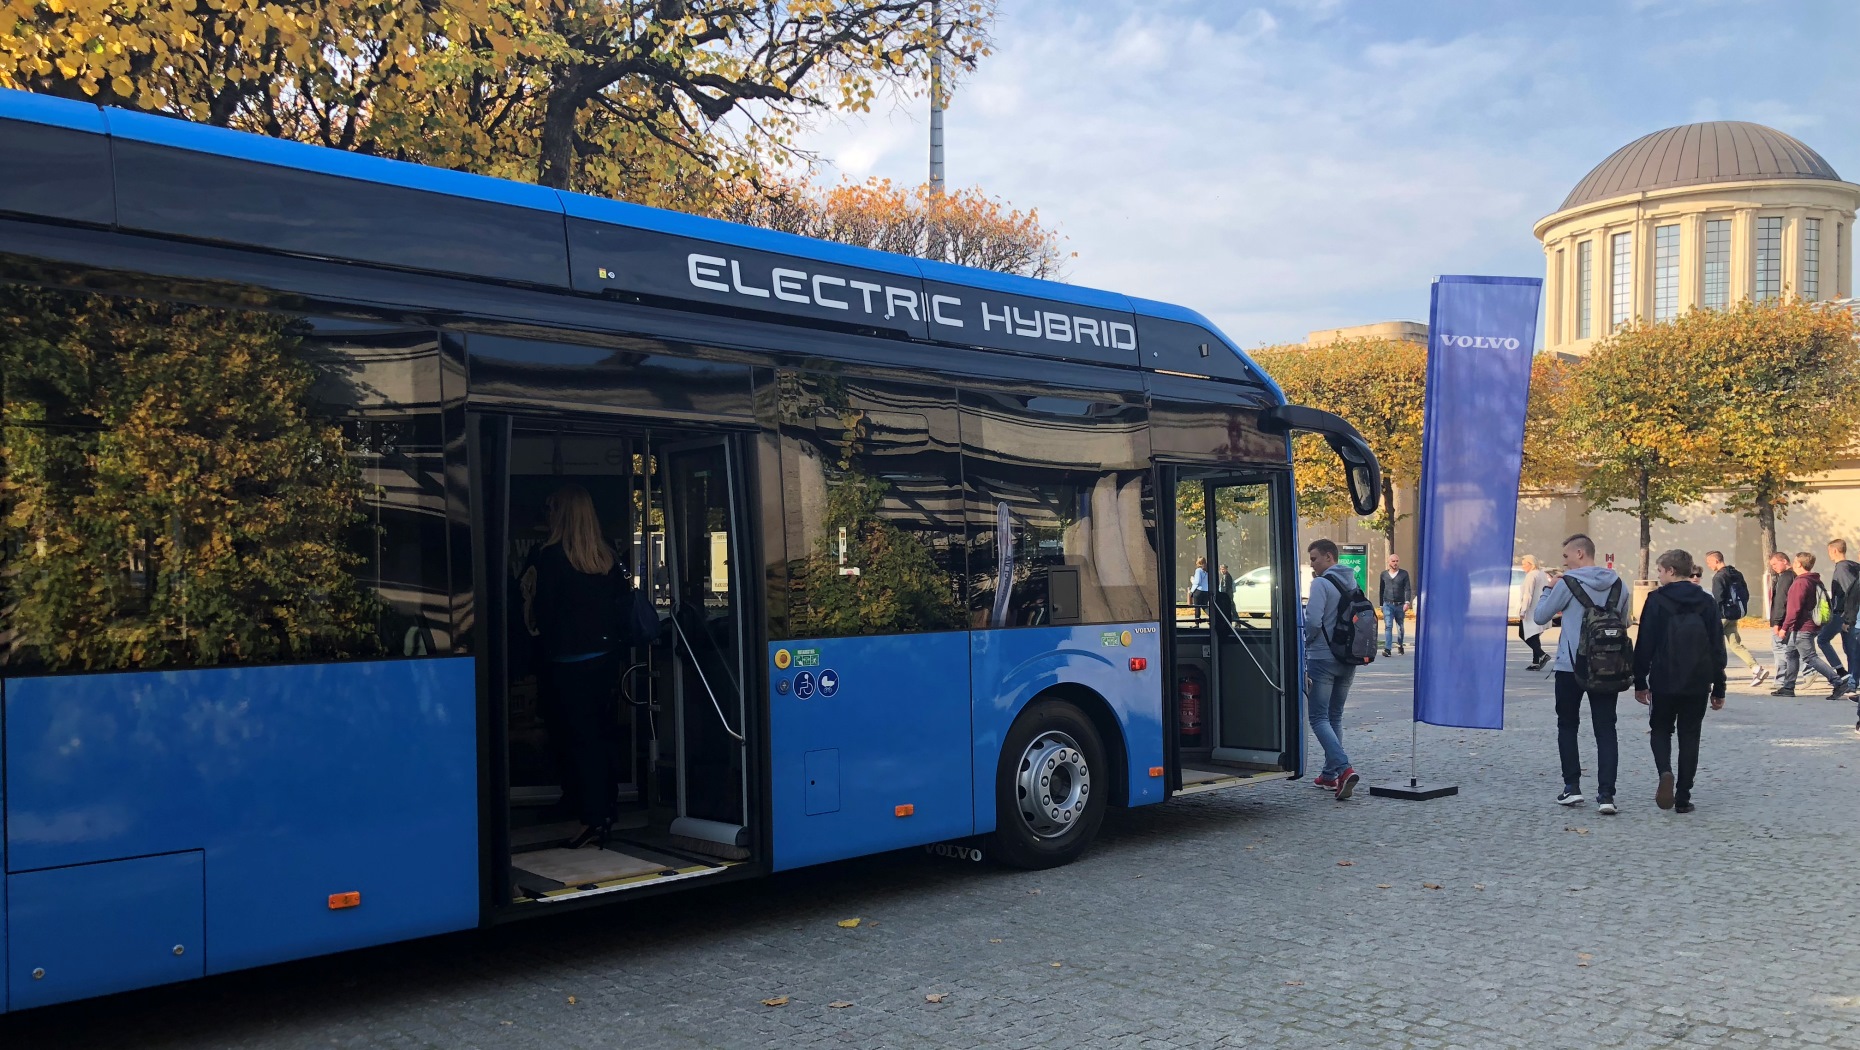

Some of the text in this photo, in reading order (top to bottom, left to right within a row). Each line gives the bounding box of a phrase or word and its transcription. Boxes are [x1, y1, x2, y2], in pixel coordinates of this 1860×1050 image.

[687, 253, 1137, 351] ELECTRIC HYBRID
[1440, 334, 1520, 350] VOLVO
[923, 843, 982, 862] VOLVO
